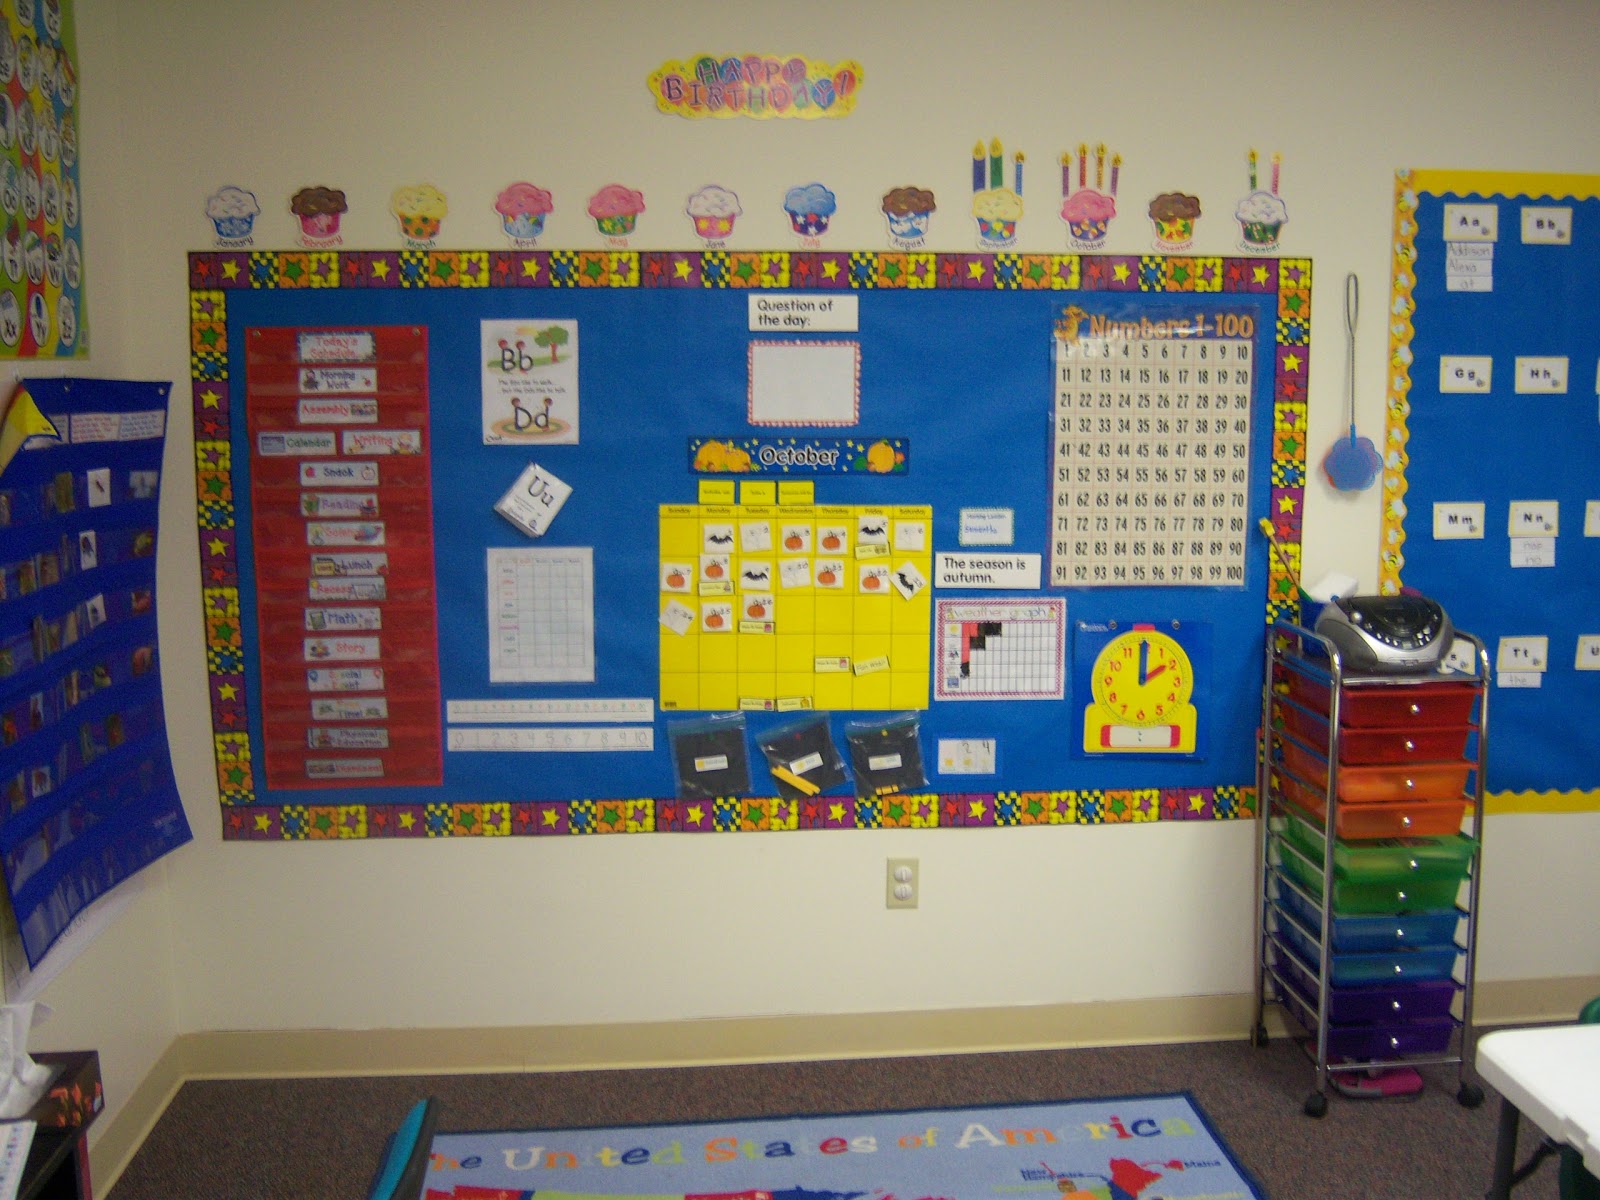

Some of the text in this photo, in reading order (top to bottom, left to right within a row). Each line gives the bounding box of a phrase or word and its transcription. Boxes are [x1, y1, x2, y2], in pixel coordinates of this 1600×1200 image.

[698, 57, 804, 84] HAPPY
[757, 298, 834, 312] Question of
[758, 314, 811, 329] the day:
[1089, 314, 1190, 340] Numbers
[1062, 369, 1248, 385] 11 12 13 14 15 16 17 18 19 20
[1060, 393, 1247, 409] 21 22 23 24 25 26 27 28 29 30
[287, 436, 332, 448] Calendar
[759, 445, 840, 465] October
[1059, 443, 1246, 458] 41 42 43 44 45 46 47 48 49 50
[323, 466, 354, 478] Snack
[944, 557, 1026, 570] The season is
[943, 572, 996, 585] autumn.
[1056, 567, 1243, 581] 91 92 93 94 95 96 97 98 99 100
[329, 612, 358, 625] Math
[955, 606, 1046, 621] weather graph
[1123, 647, 1133, 659] 11
[1109, 660, 1122, 672] 10
[1169, 659, 1178, 671] 2
[1104, 676, 1113, 687] 9
[1173, 676, 1182, 688] 3
[1109, 692, 1117, 704] 8
[1167, 692, 1176, 704] 4
[1120, 704, 1129, 716] 7
[1136, 709, 1145, 721] 6
[1155, 704, 1164, 716] 5
[503, 1139, 687, 1170] United
[703, 1134, 878, 1164] States
[899, 1126, 939, 1149] of
[954, 1114, 1196, 1149] America
